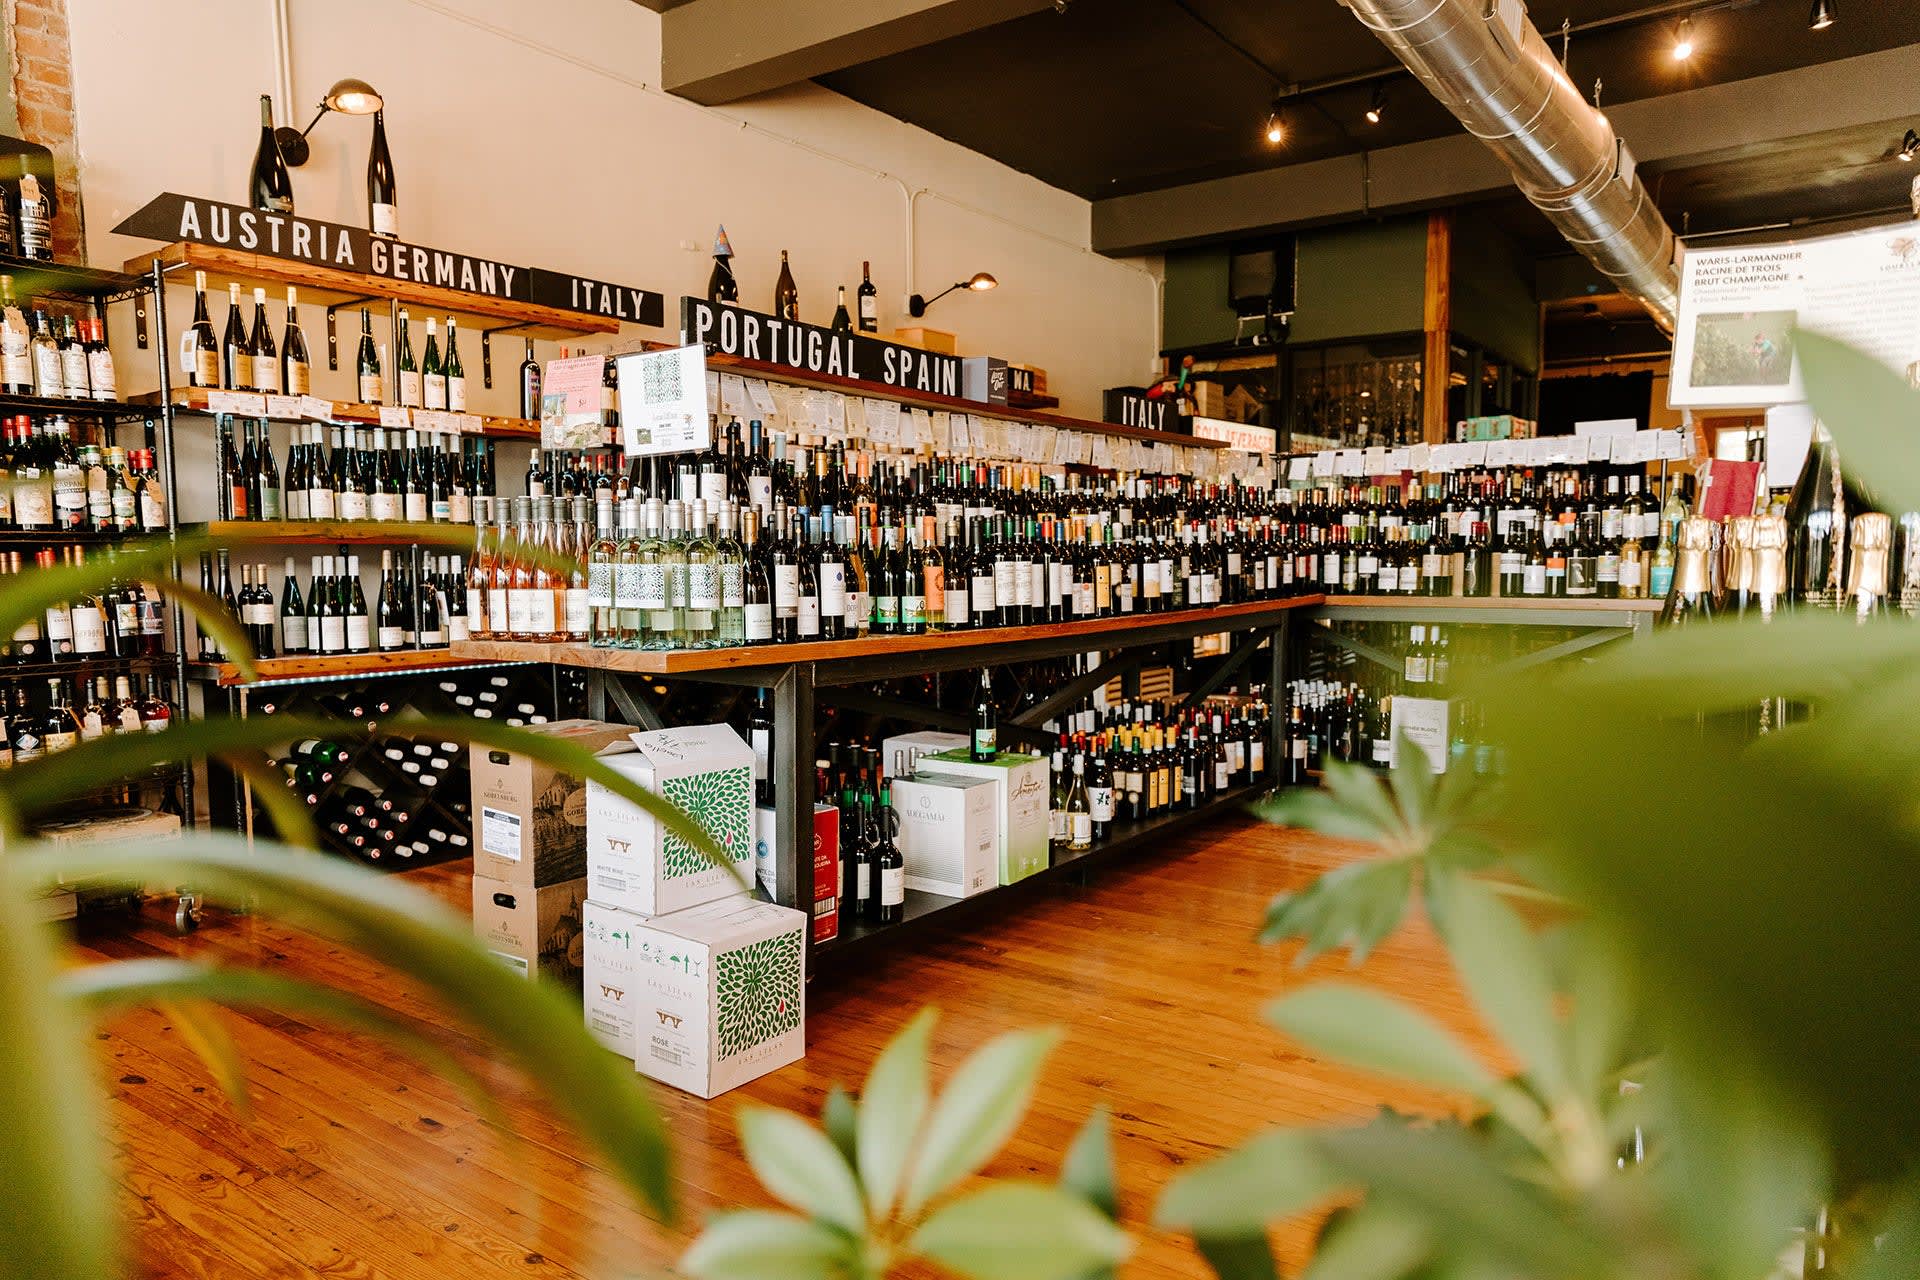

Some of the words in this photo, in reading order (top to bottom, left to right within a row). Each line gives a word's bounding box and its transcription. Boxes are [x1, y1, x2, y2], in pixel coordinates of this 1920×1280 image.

[179, 200, 355, 265] AUSTRIA
[372, 239, 515, 298] GERMANY
[1695, 266, 1732, 276] RACINE
[1735, 265, 1747, 274] DE
[1751, 263, 1781, 272] TROIS
[1696, 252, 1802, 266] WARIS-LARMANDIER
[571, 278, 645, 321] ITALY
[1694, 277, 1720, 287] BRUT
[1722, 273, 1790, 284] CHAMPAGNE
[696, 303, 860, 380] PORTUGAL
[883, 346, 957, 397] SPAIN
[1122, 395, 1165, 431] ITALY
